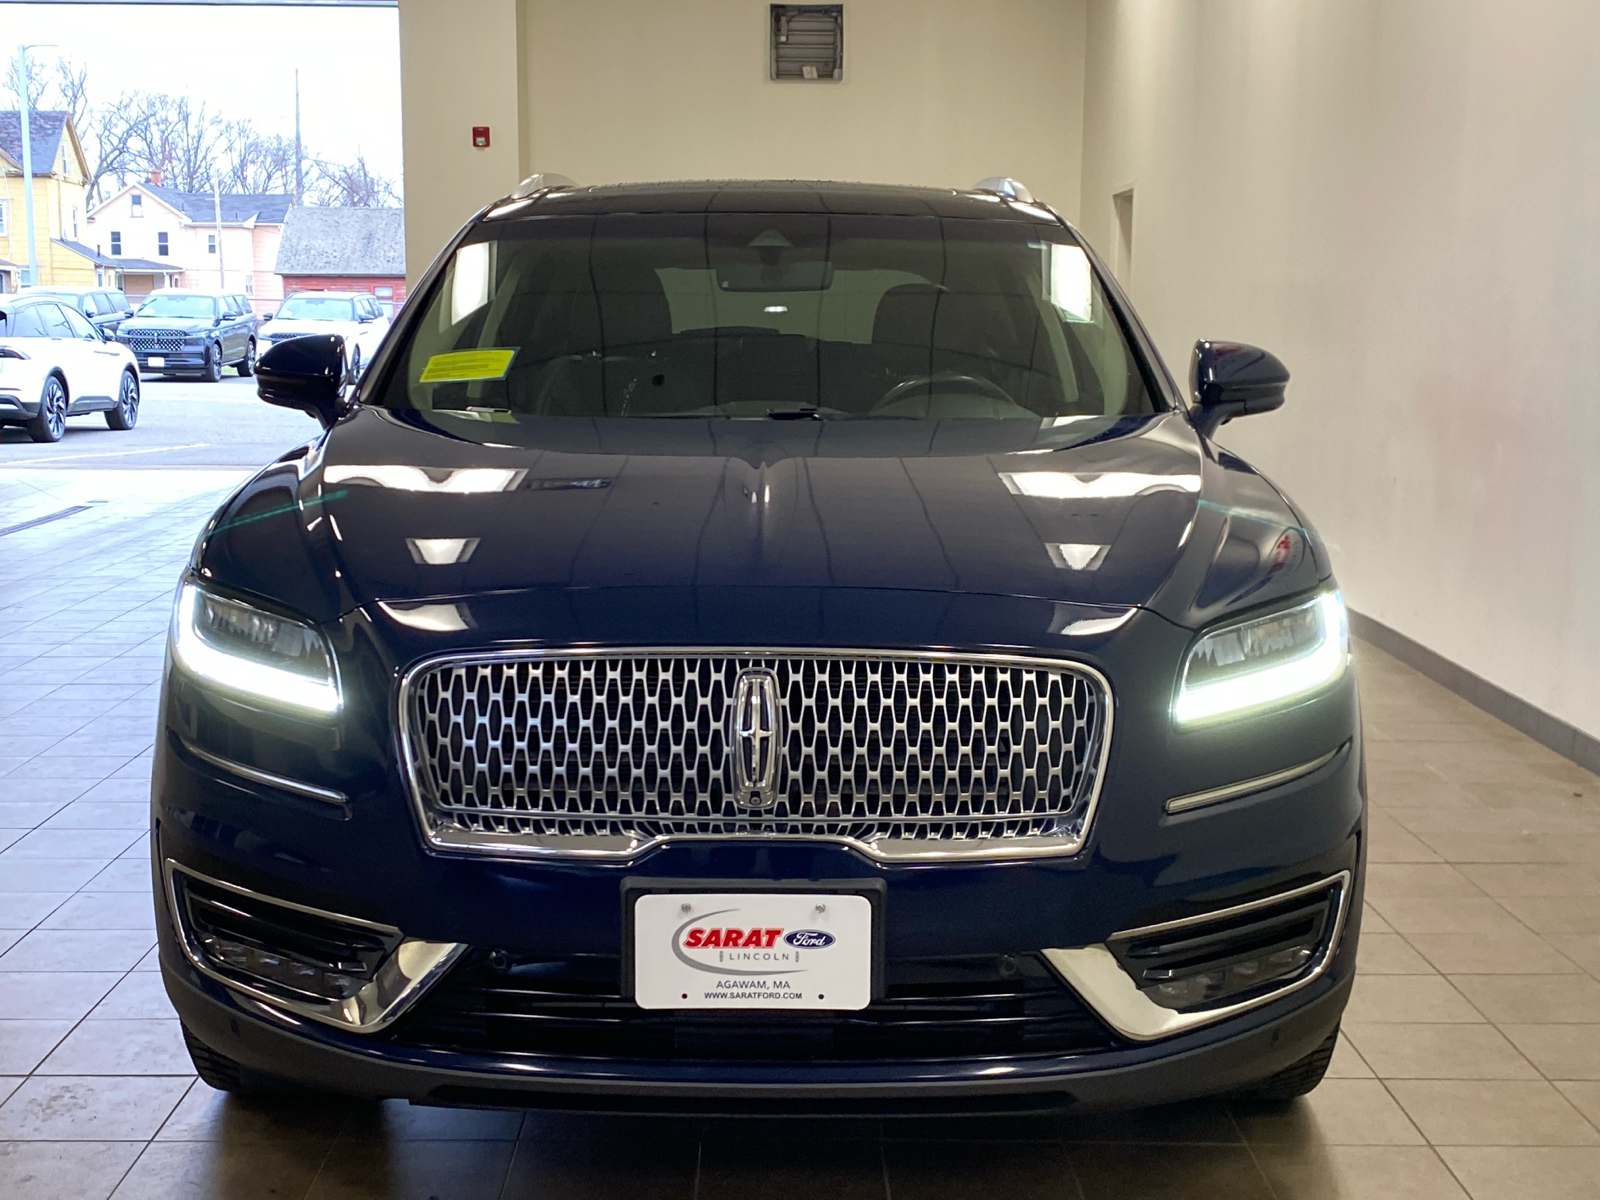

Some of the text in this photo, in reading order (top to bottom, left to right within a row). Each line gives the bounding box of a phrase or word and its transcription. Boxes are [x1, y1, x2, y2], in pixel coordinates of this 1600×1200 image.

[683, 928, 826, 948] SARAT Ford
[729, 953, 790, 961] LINCOLN
[716, 980, 791, 990] AGAWAM, MA
[704, 992, 803, 1000] WWW.SARATFORD.COM
